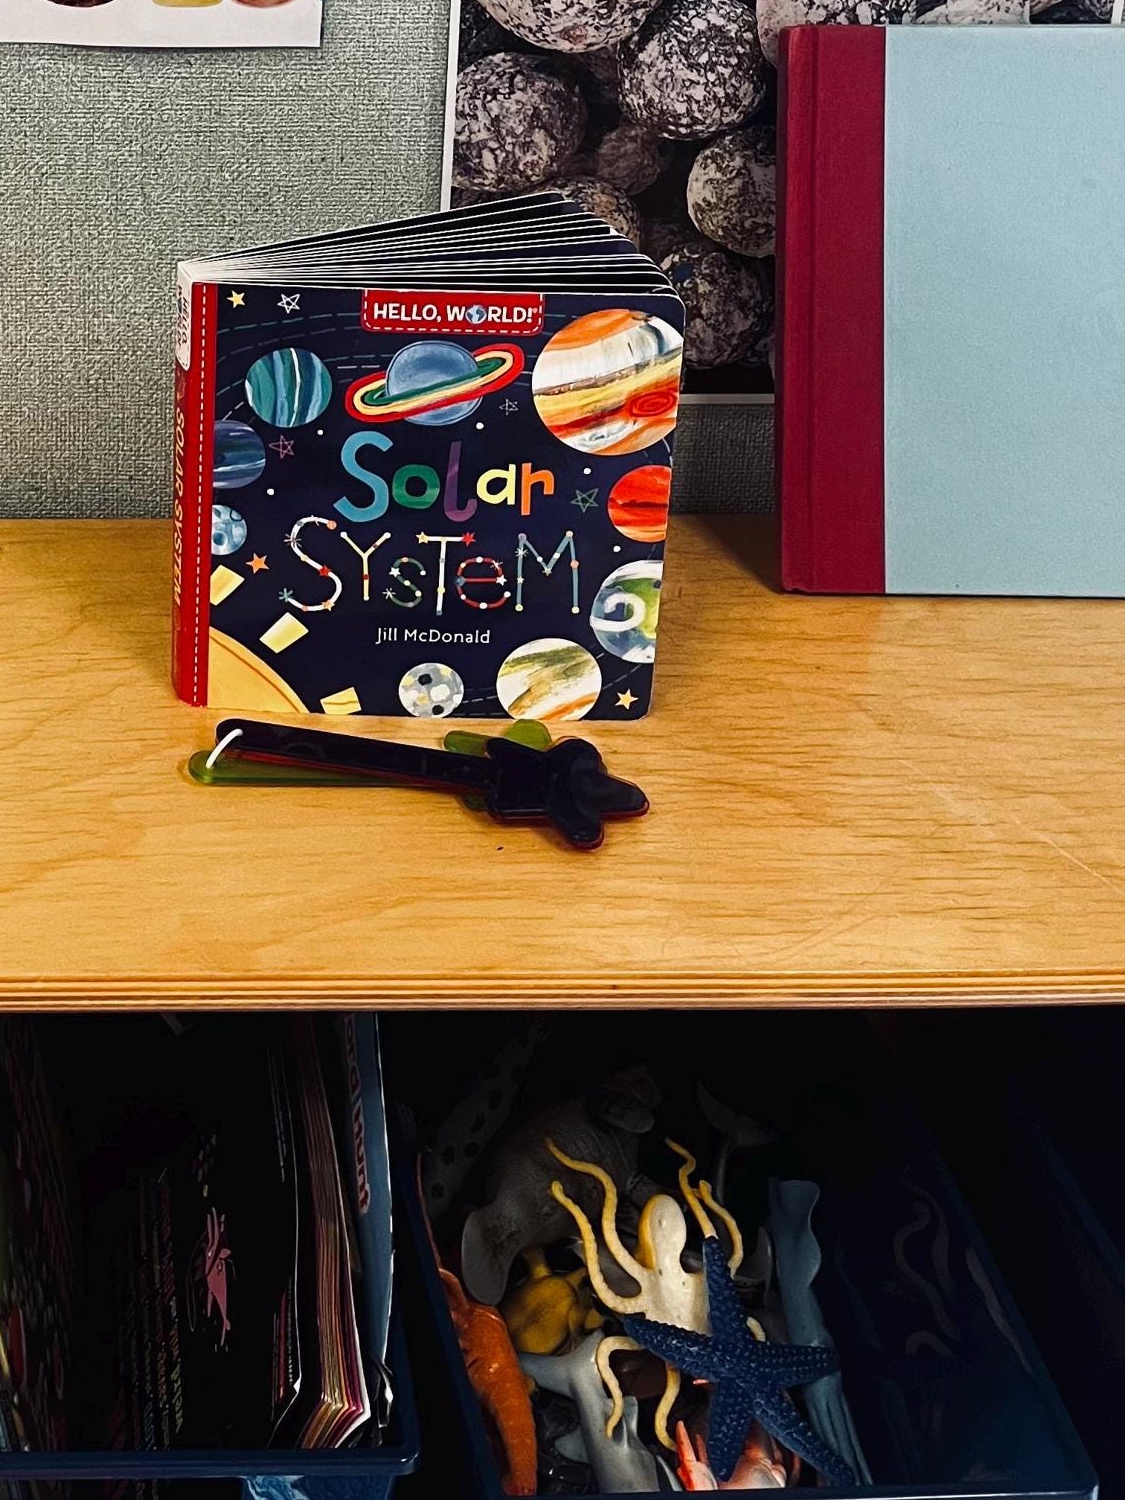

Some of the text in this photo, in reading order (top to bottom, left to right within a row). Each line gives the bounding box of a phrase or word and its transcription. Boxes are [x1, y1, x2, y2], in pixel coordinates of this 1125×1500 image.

[373, 302, 442, 323] HELLO,
[173, 407, 184, 607] SOLAR SYSTEM
[333, 430, 555, 522] Solar
[375, 627, 491, 645] Jill McDonald
[342, 1011, 371, 1213] ord Hunt
